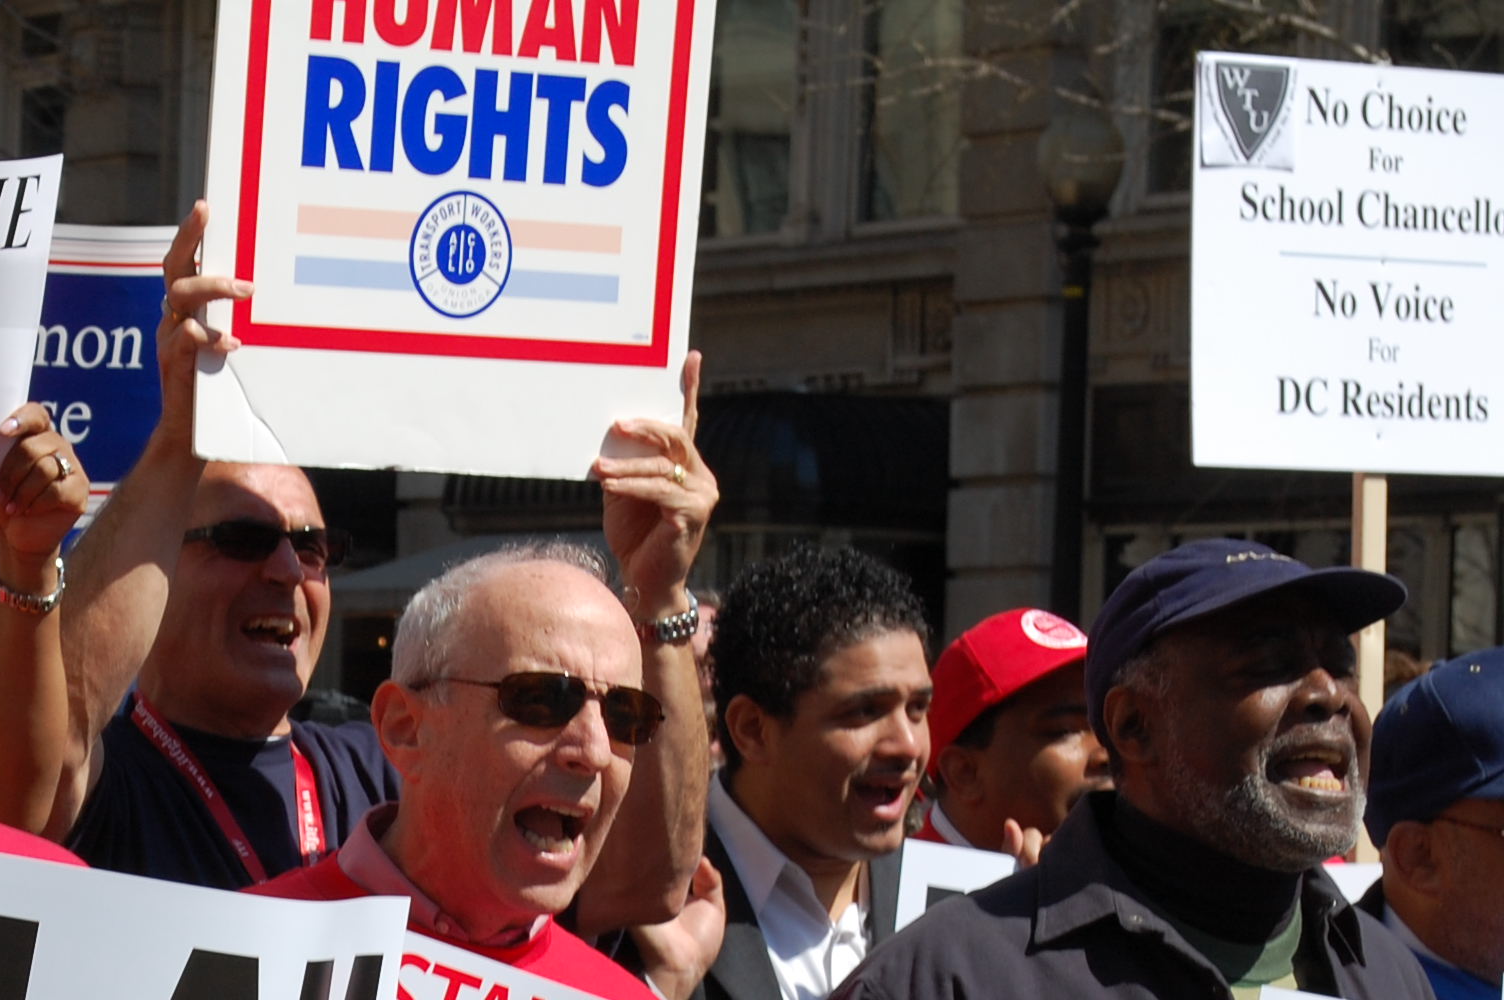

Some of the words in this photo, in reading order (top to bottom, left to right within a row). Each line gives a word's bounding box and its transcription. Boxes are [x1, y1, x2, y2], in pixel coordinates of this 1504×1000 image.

[301, 54, 630, 188] RIGHTS
[1305, 85, 1350, 128] No
[1360, 90, 1468, 136] Choice
[1368, 146, 1405, 173] For
[1239, 181, 1345, 227] School
[1356, 189, 1504, 237] Chancello
[419, 200, 462, 272] TRANSPORT
[471, 202, 503, 271] WORKERS
[1312, 277, 1358, 319] No
[1368, 281, 1455, 323] Voice
[1367, 336, 1401, 363] For
[1277, 374, 1329, 417] DC
[1340, 377, 1490, 422] Residents
